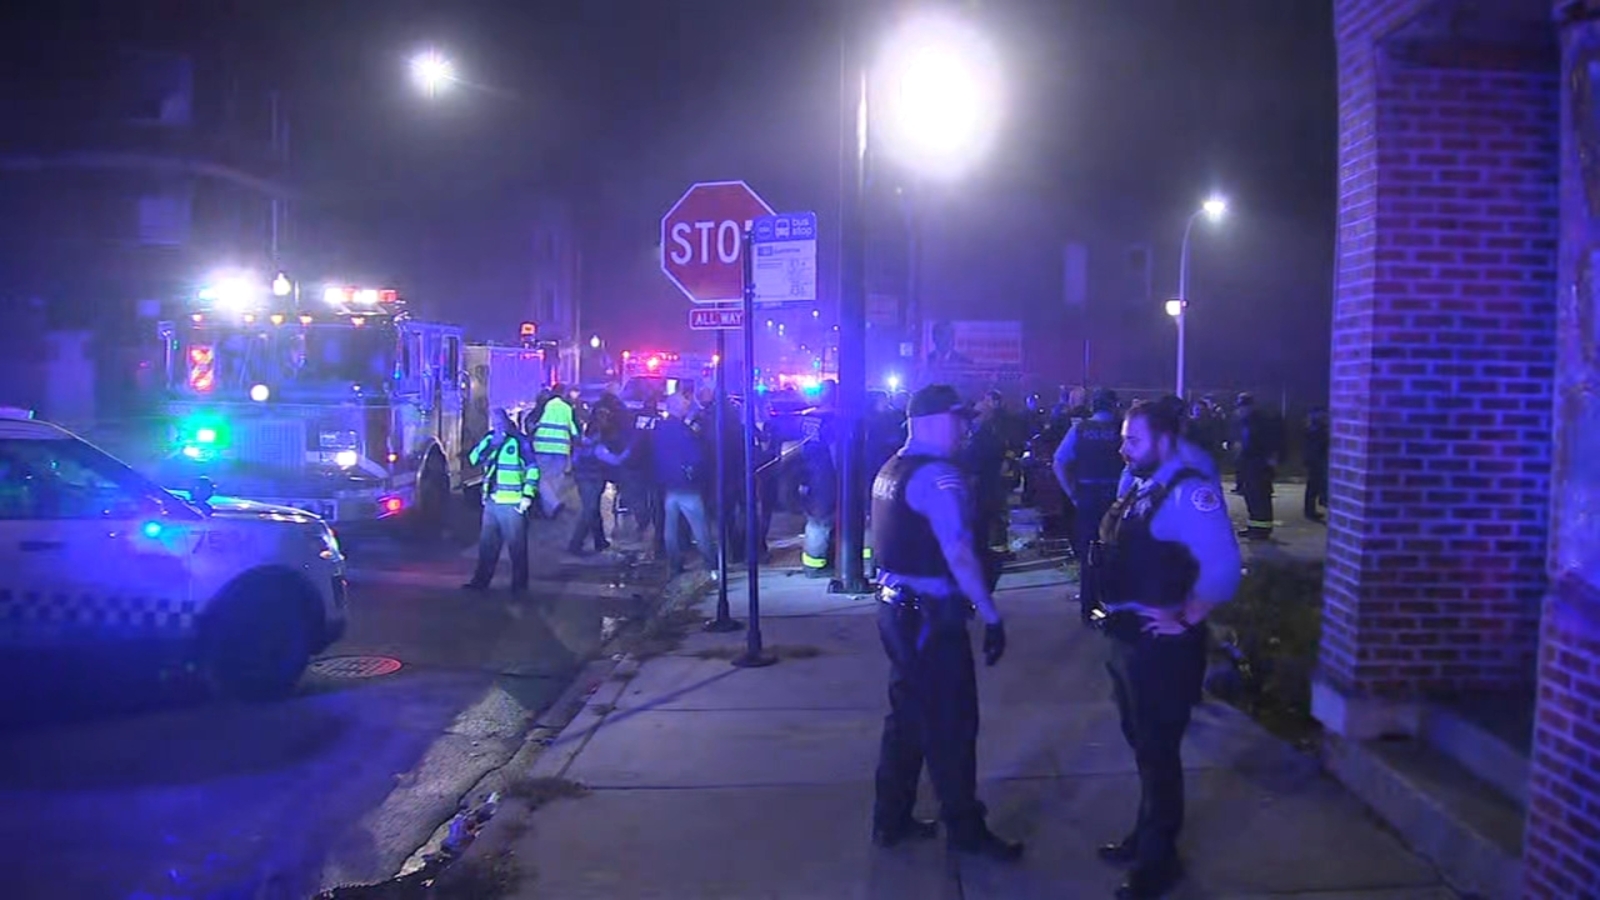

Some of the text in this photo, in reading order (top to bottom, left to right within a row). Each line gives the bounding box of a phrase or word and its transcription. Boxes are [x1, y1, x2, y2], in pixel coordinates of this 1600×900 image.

[792, 217, 810, 227] bus
[792, 227, 813, 239] stop
[671, 219, 753, 265] STO
[694, 311, 743, 326] ALL WAY
